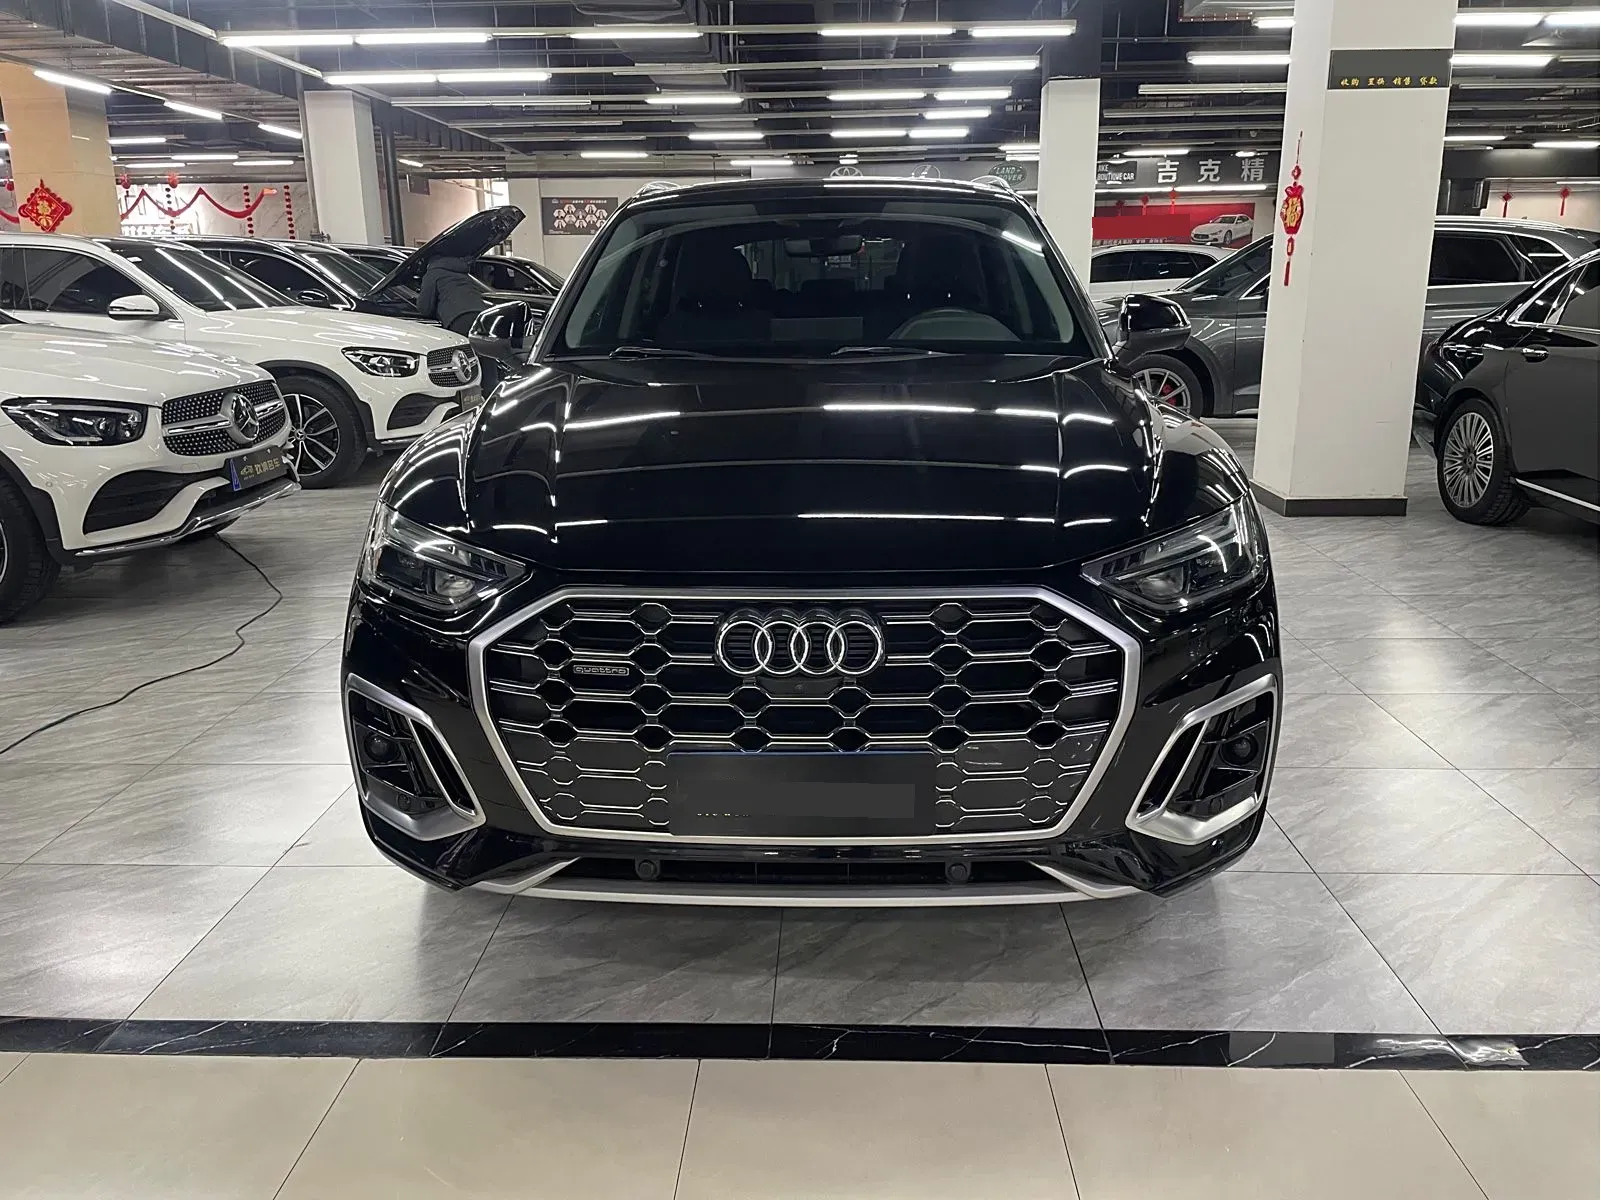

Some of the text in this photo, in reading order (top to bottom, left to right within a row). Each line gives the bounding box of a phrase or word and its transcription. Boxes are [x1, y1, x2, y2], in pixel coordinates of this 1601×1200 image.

[1393, 77, 1411, 86] 销售
[1420, 77, 1438, 86] 贷款
[1157, 158, 1265, 184] 吉克精
[1123, 172, 1135, 181] CAR
[576, 666, 626, 674] quattro
